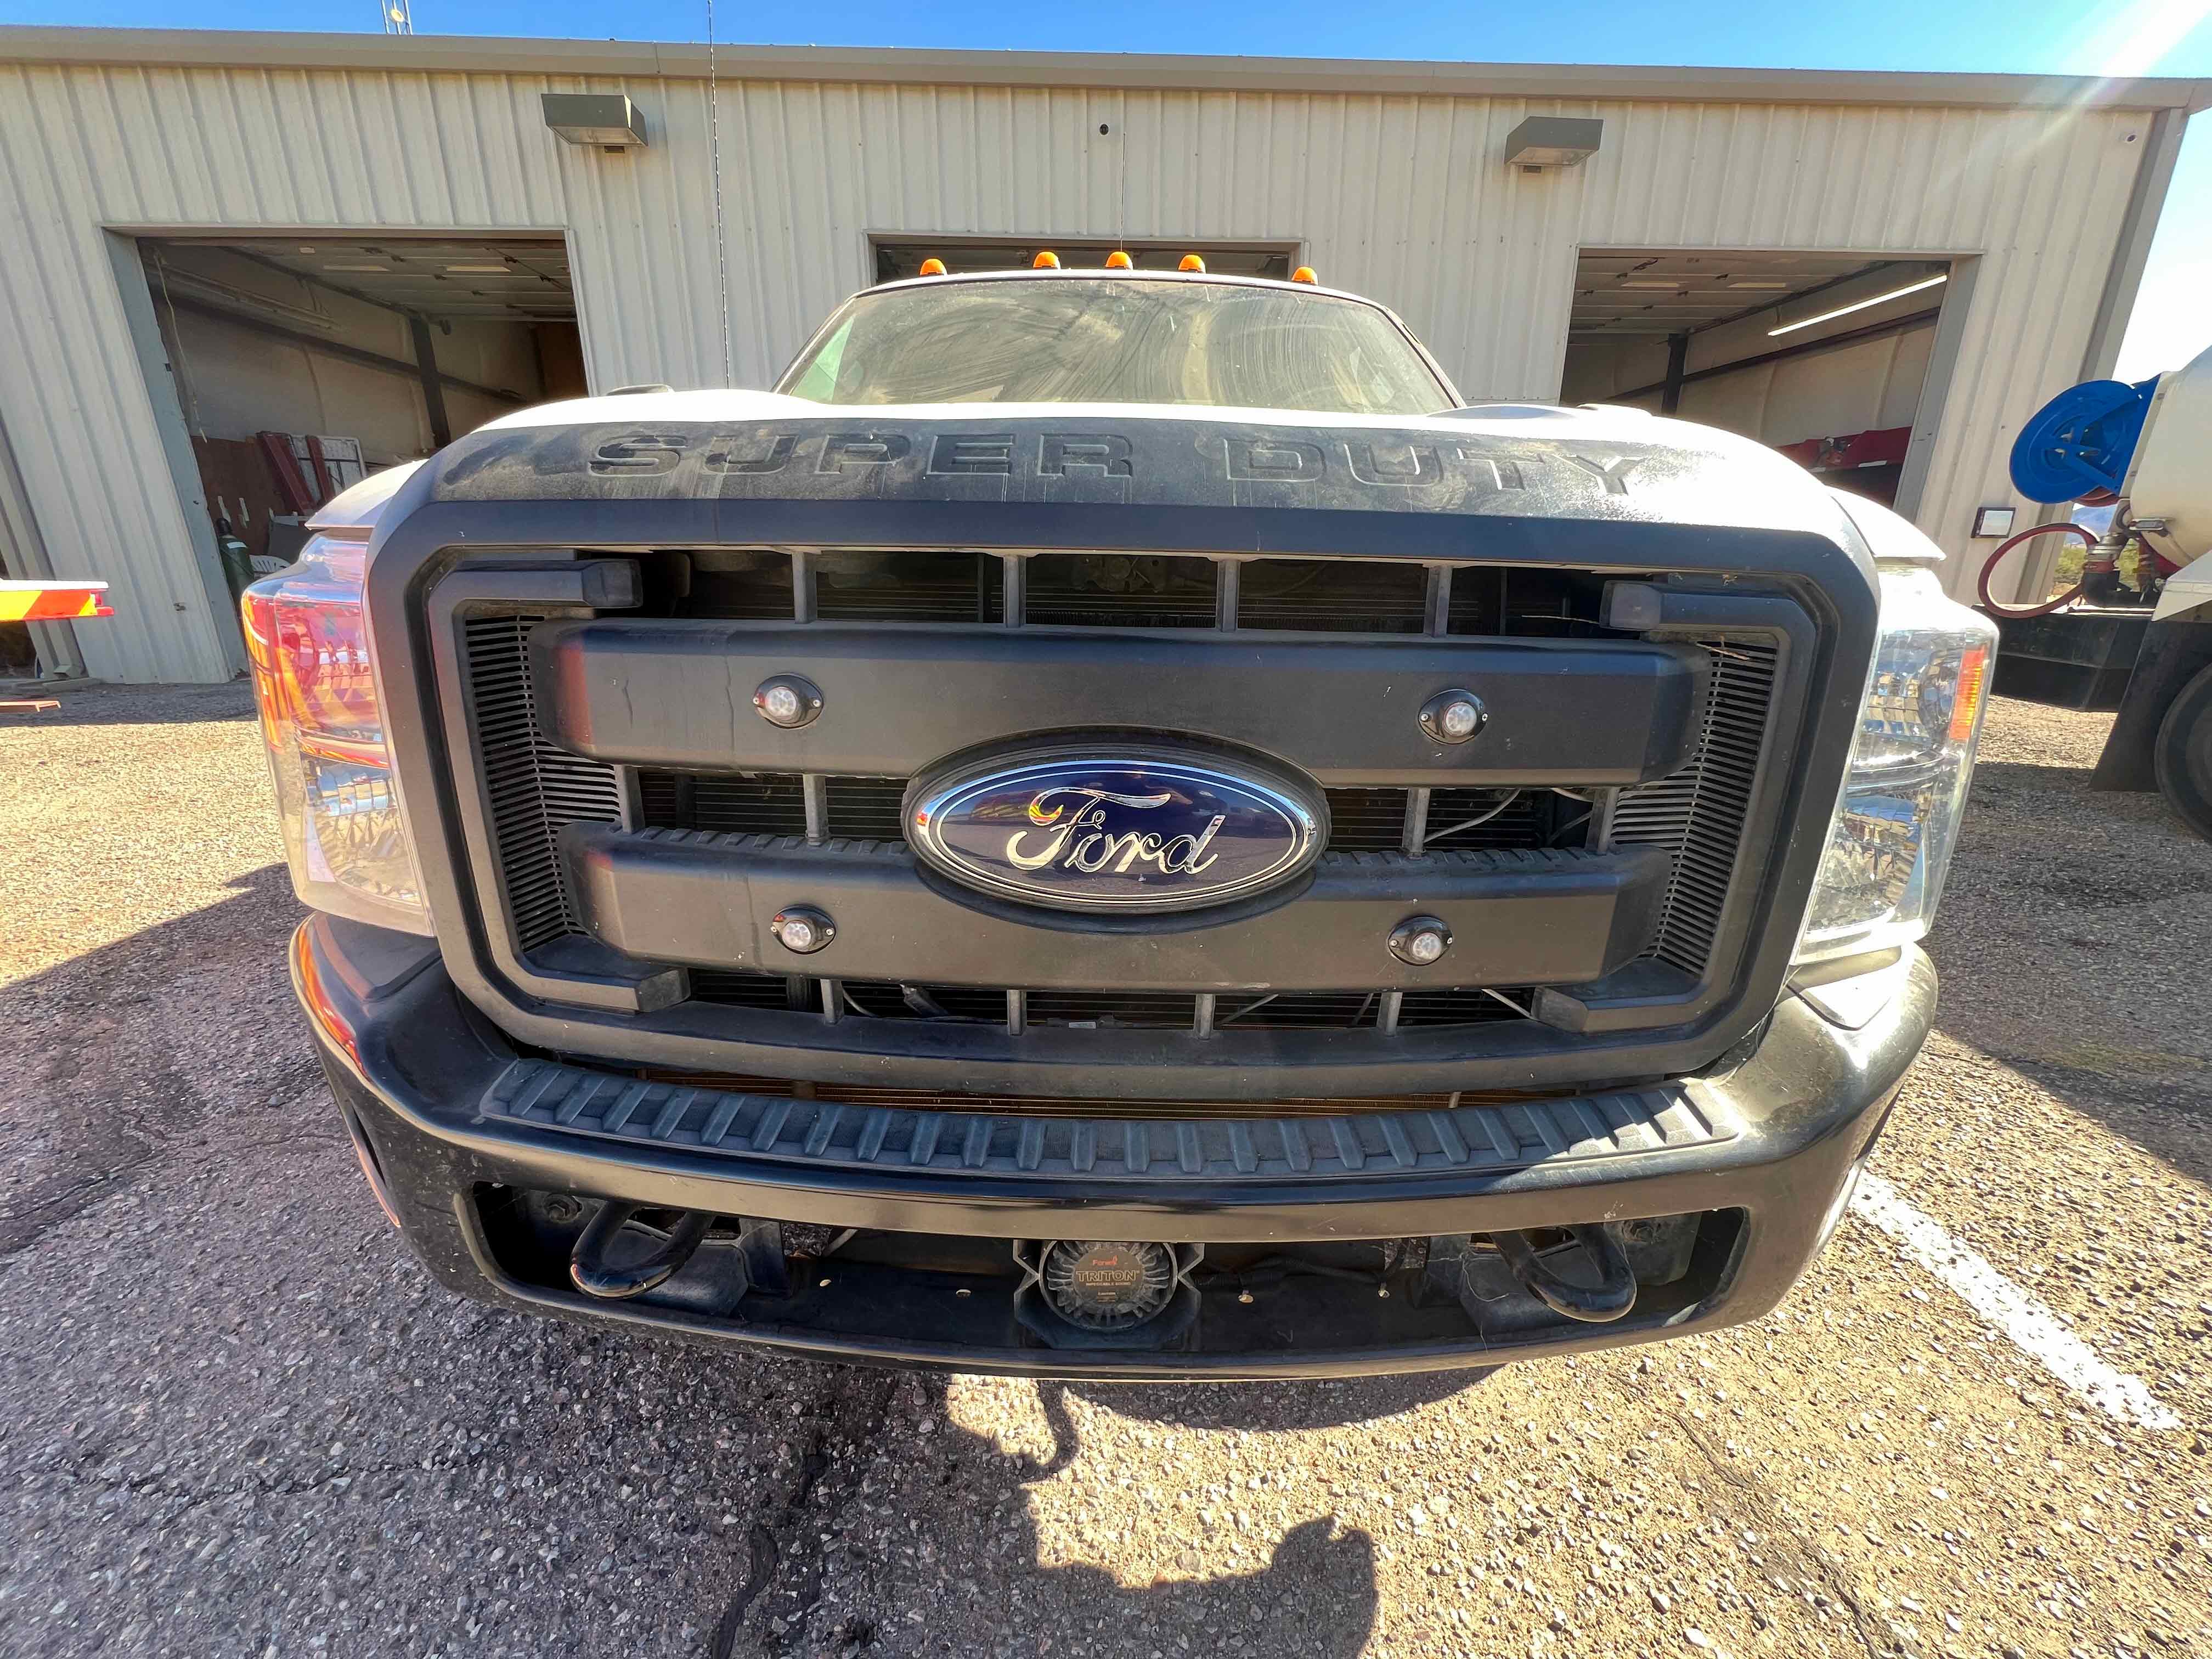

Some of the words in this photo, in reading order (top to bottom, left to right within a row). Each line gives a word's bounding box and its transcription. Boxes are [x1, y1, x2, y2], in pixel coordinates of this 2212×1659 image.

[588, 432, 1133, 478] SUPER
[1223, 438, 1645, 496] DUTY
[1006, 786, 1227, 875] Ford
[1075, 1270, 1137, 1282] TRITON
